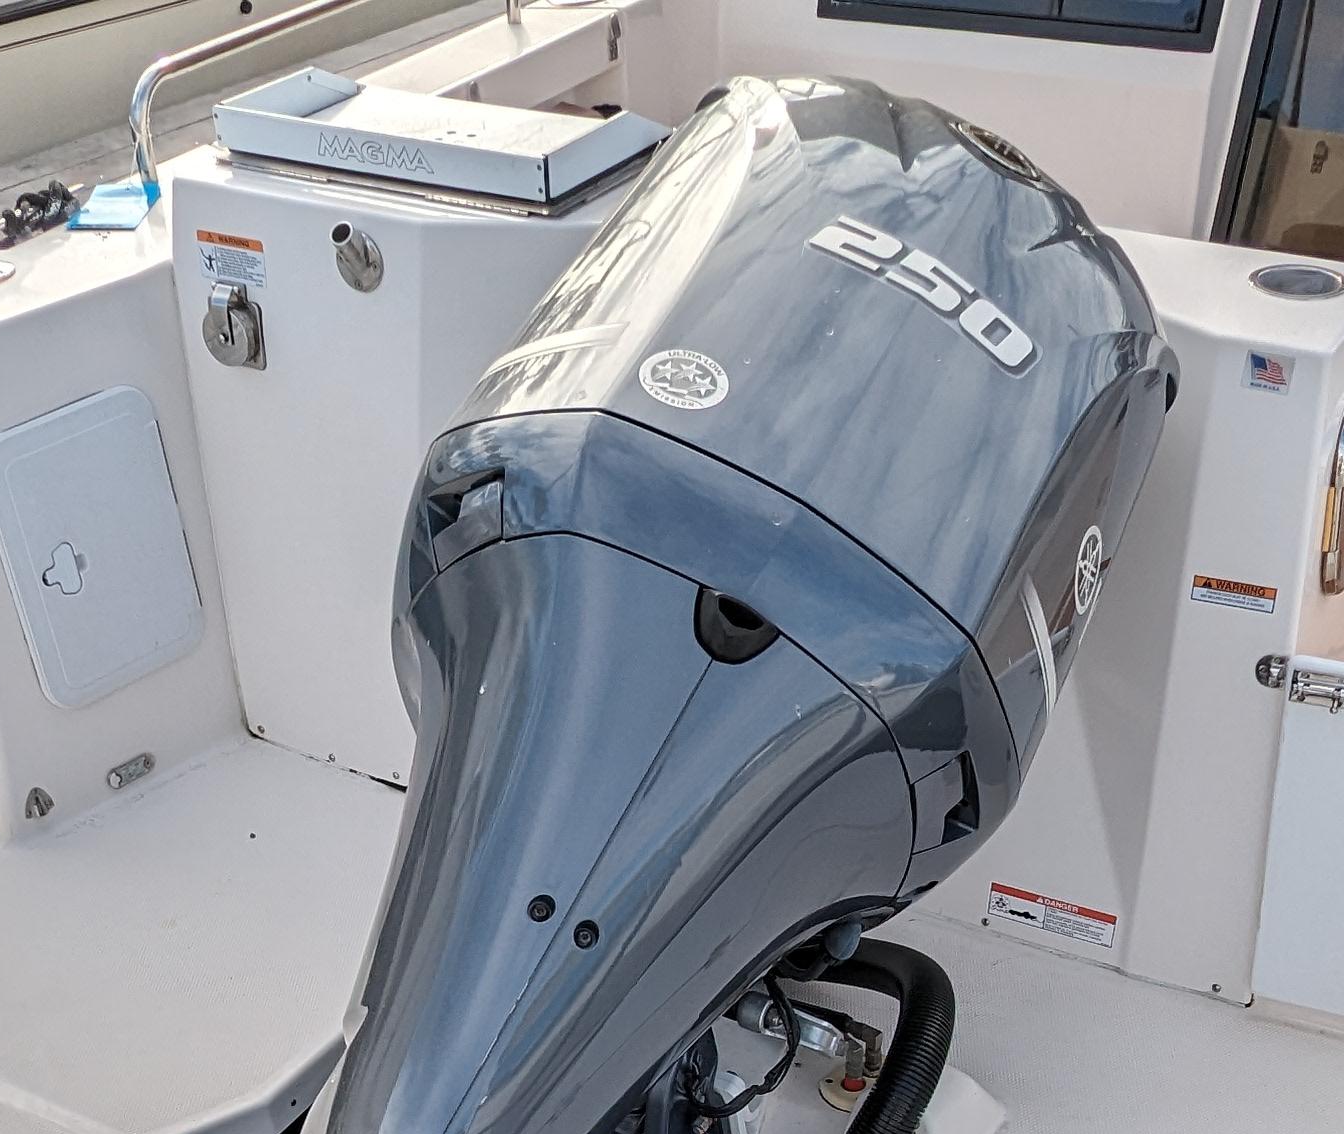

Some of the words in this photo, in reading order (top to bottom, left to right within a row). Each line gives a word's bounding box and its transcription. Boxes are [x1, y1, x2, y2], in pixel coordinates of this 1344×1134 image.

[316, 131, 435, 175] MAGMA
[218, 235, 250, 247] WARNING
[807, 214, 1035, 368] 250
[1216, 580, 1266, 597] WARNING
[1044, 898, 1079, 913] DANGER
